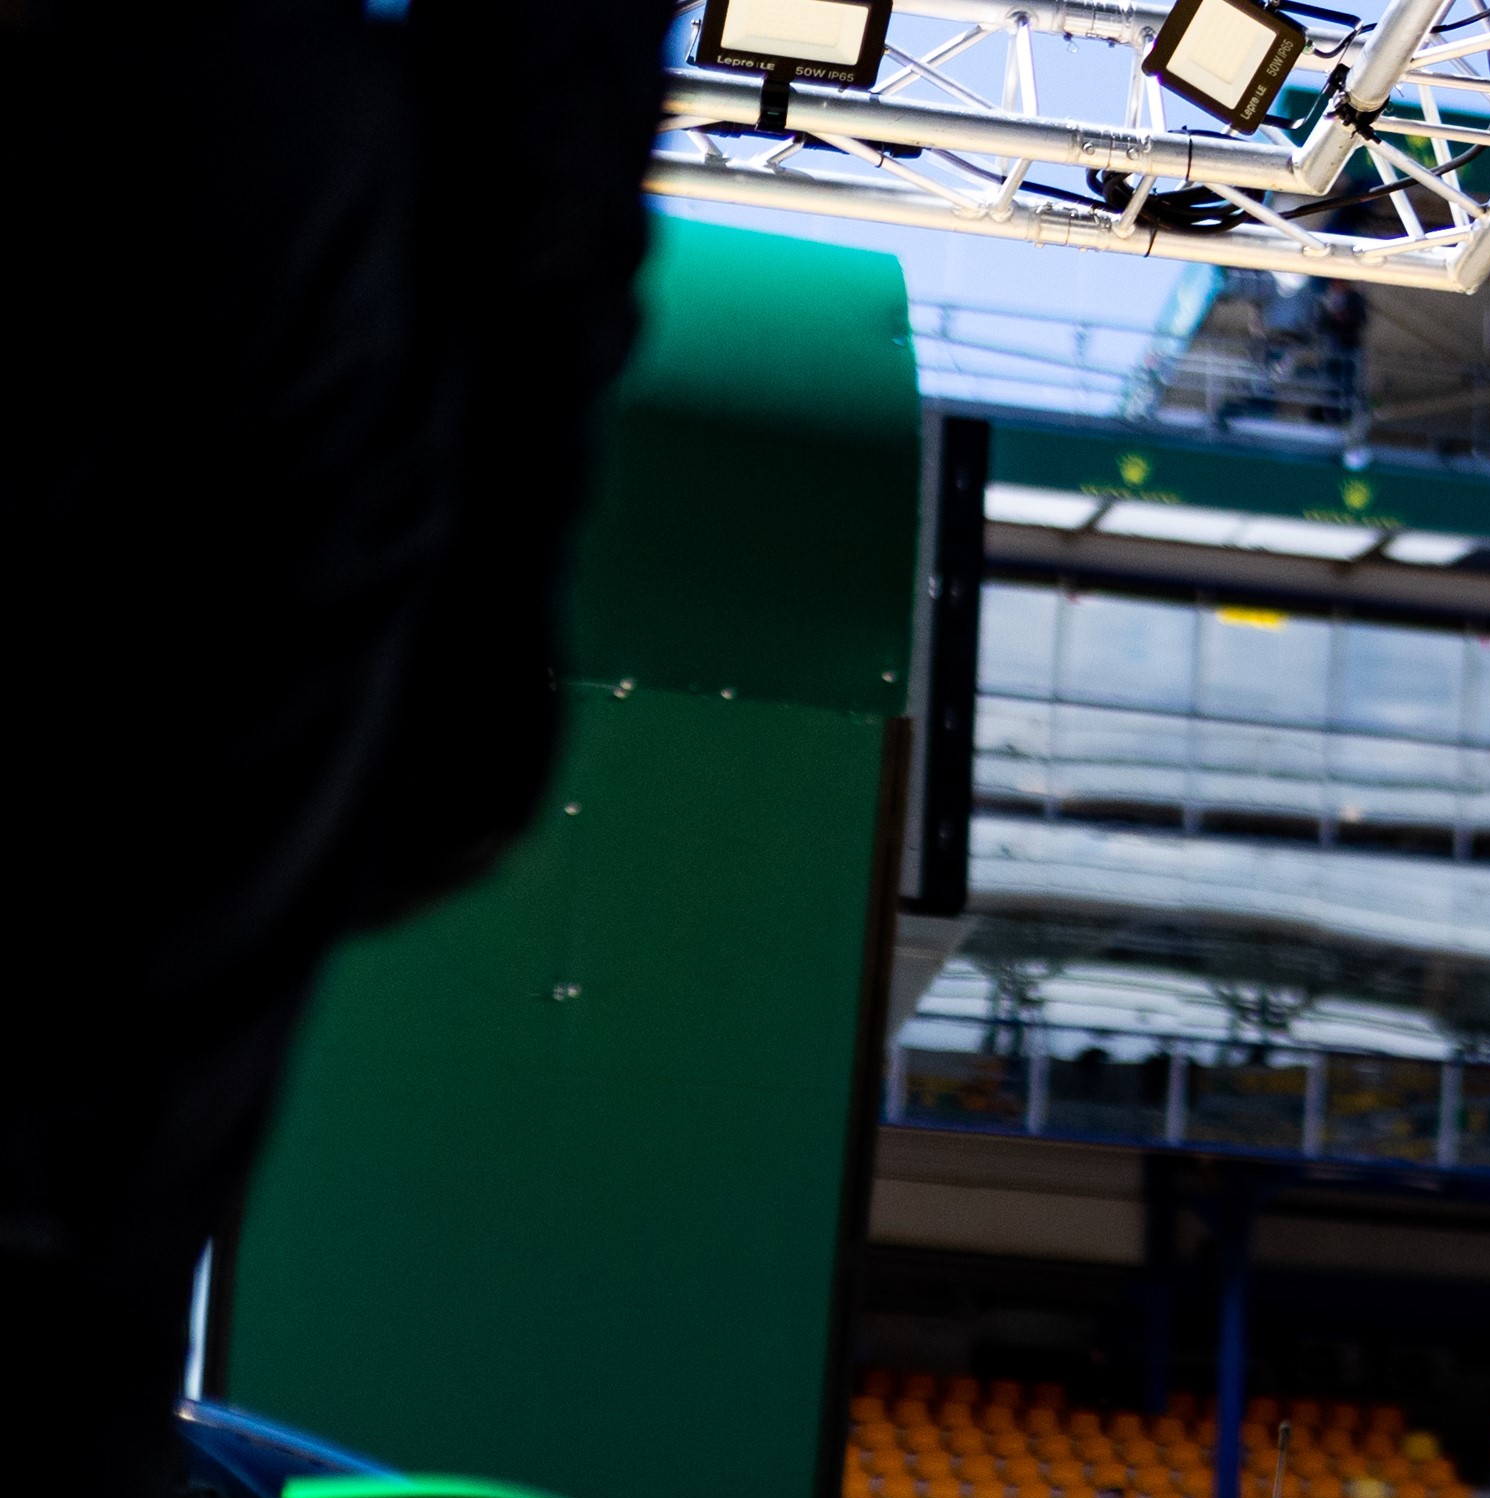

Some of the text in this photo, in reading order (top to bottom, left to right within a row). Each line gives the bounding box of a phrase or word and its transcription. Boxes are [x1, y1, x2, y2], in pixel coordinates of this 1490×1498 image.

[1266, 57, 1285, 78] 50W
[1281, 39, 1294, 60] IP65
[795, 66, 827, 79] 50W
[828, 70, 855, 83] IP65
